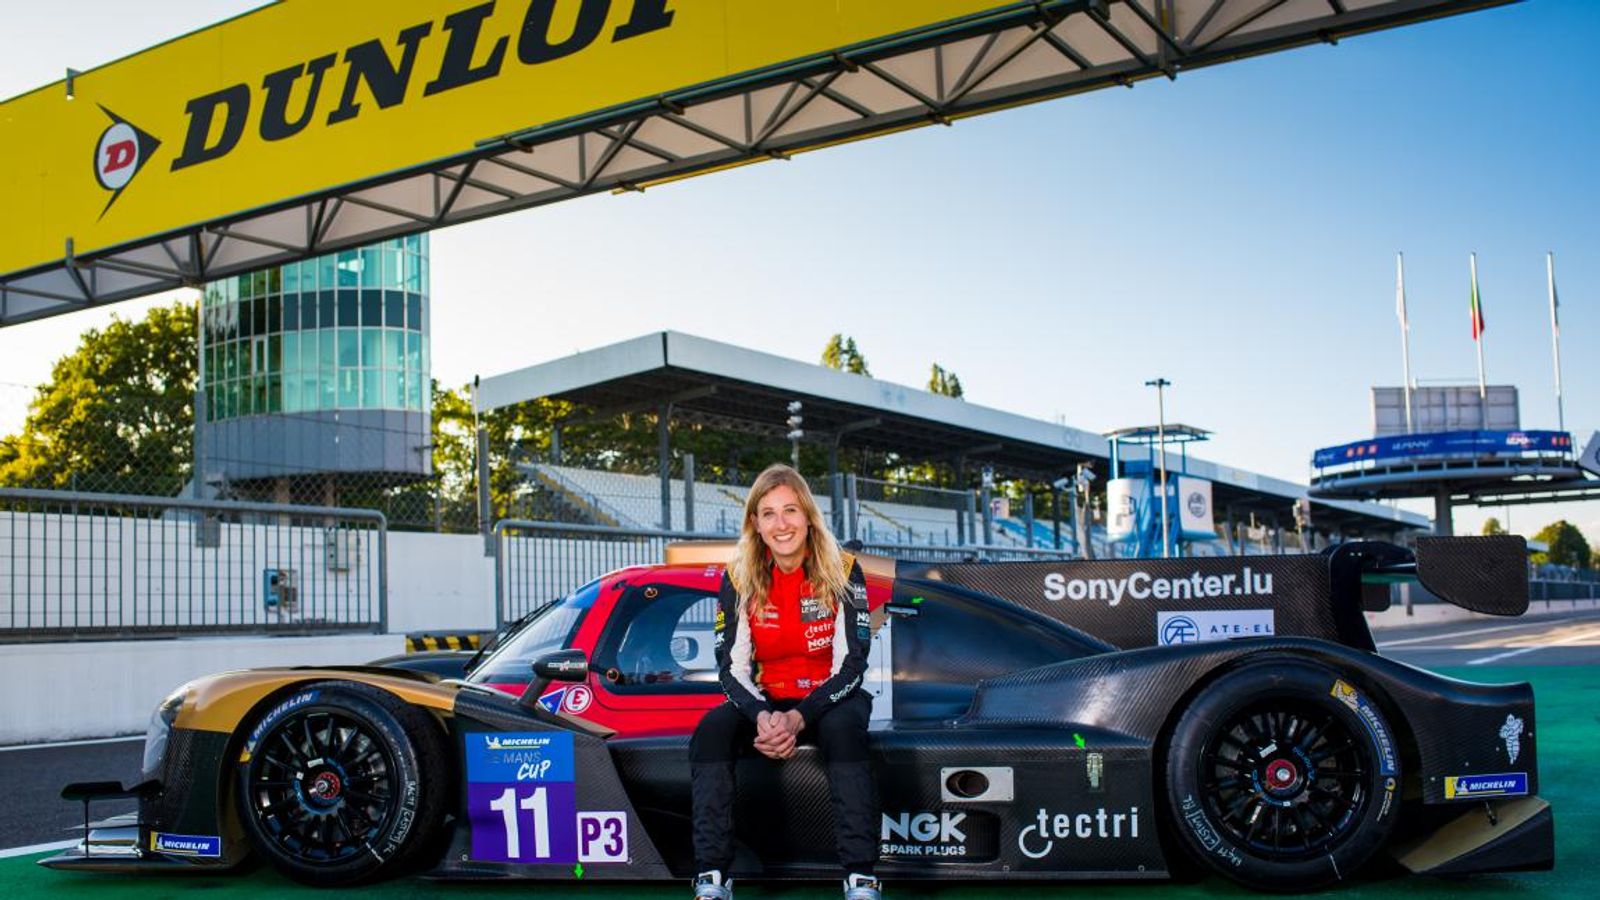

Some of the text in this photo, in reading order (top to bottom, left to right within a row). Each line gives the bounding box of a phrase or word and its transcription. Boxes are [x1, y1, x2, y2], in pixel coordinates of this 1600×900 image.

[103, 140, 136, 174] D
[1044, 567, 1273, 606] SonyCenter.lu
[573, 690, 584, 705] E
[254, 692, 313, 739] MICHELIN
[502, 738, 550, 746] MICHELIN
[1361, 705, 1394, 771] MICHELIN
[517, 759, 551, 780] CUP
[1469, 780, 1516, 791] MICHELIN
[490, 787, 551, 858] 11
[580, 817, 624, 857] P3
[881, 811, 967, 842] NGK
[1036, 807, 1139, 838] tectri
[164, 840, 210, 850] MICHELIN
[881, 844, 967, 855] SPARK PLUGS
